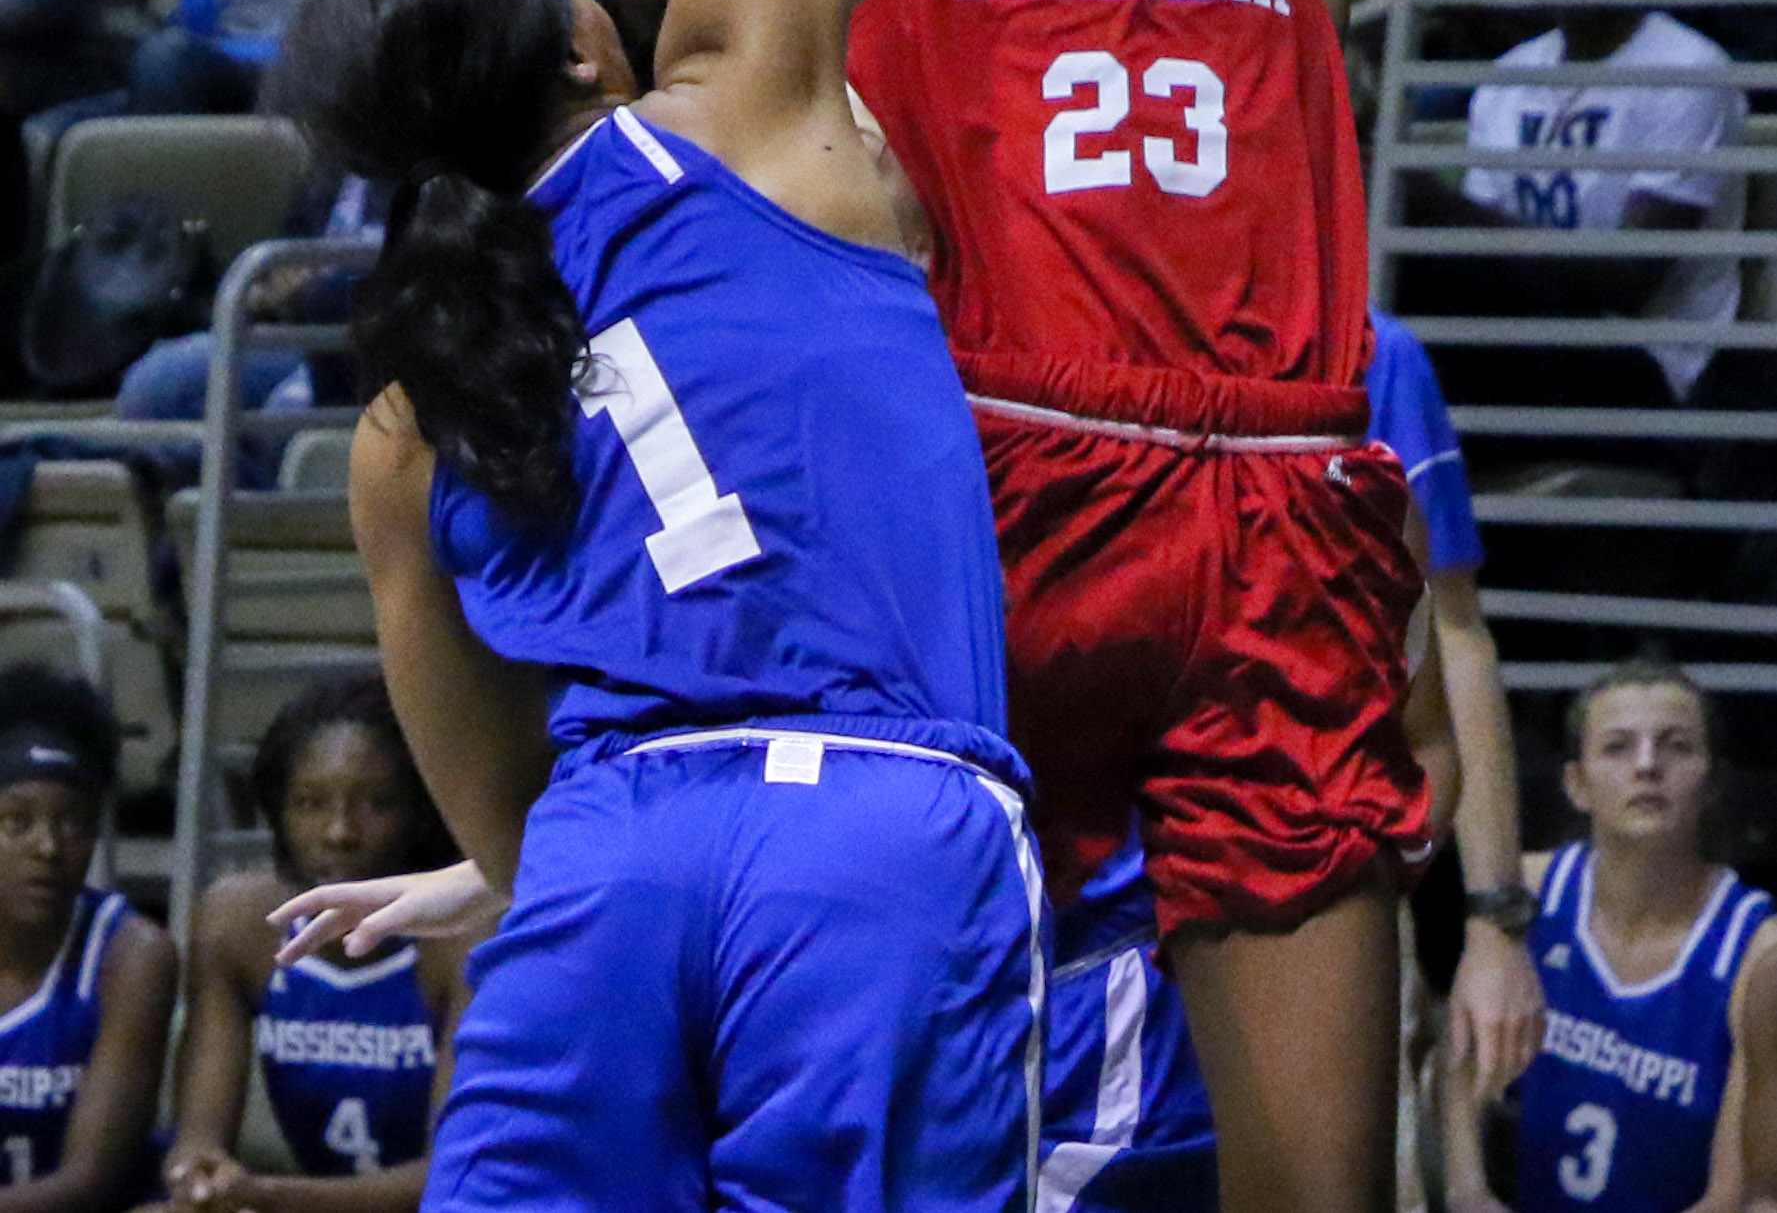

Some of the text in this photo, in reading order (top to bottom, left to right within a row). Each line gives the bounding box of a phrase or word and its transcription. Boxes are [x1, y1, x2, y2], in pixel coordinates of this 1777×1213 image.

[1042, 50, 1229, 198] 23
[570, 317, 762, 595] 1
[325, 1097, 380, 1176] 4
[1557, 1101, 1618, 1203] 3
